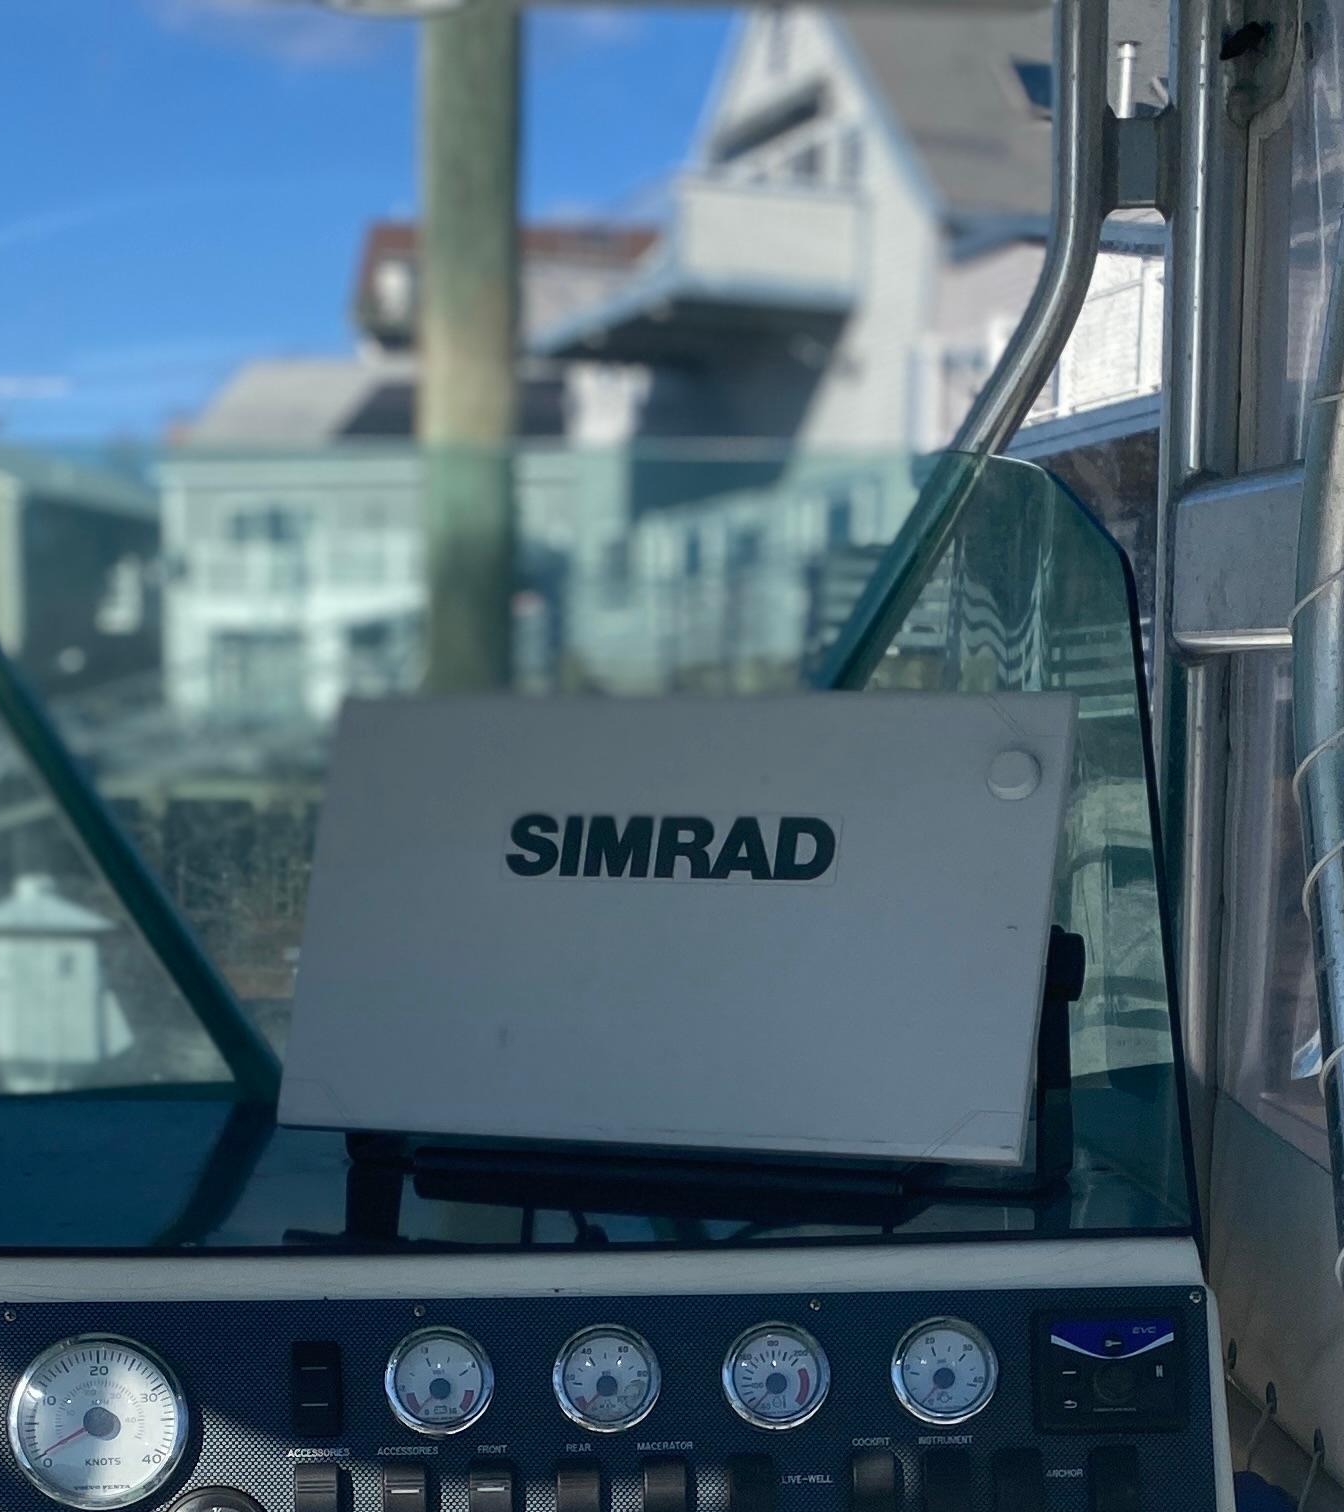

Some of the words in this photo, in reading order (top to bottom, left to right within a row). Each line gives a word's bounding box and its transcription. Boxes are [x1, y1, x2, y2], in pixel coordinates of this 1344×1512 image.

[505, 814, 836, 881] SIMRAD
[1132, 1326, 1156, 1334] EVC
[89, 1365, 109, 1376] 20
[141, 1393, 158, 1403] 30
[851, 1436, 891, 1447] COCKPIT
[918, 1434, 974, 1445] INSTRUMENT
[377, 1446, 439, 1456] ACCESSORIES
[477, 1444, 507, 1454] FRONT
[566, 1442, 592, 1452] REAR
[636, 1441, 693, 1451] MACERATOR
[287, 1448, 350, 1457] ACCESSORIES
[43, 1457, 53, 1468] 0
[85, 1457, 122, 1466] KNOTS
[141, 1455, 162, 1464] 40
[1045, 1468, 1084, 1478] ANCHOR
[781, 1474, 833, 1485] LIVE-WELL
